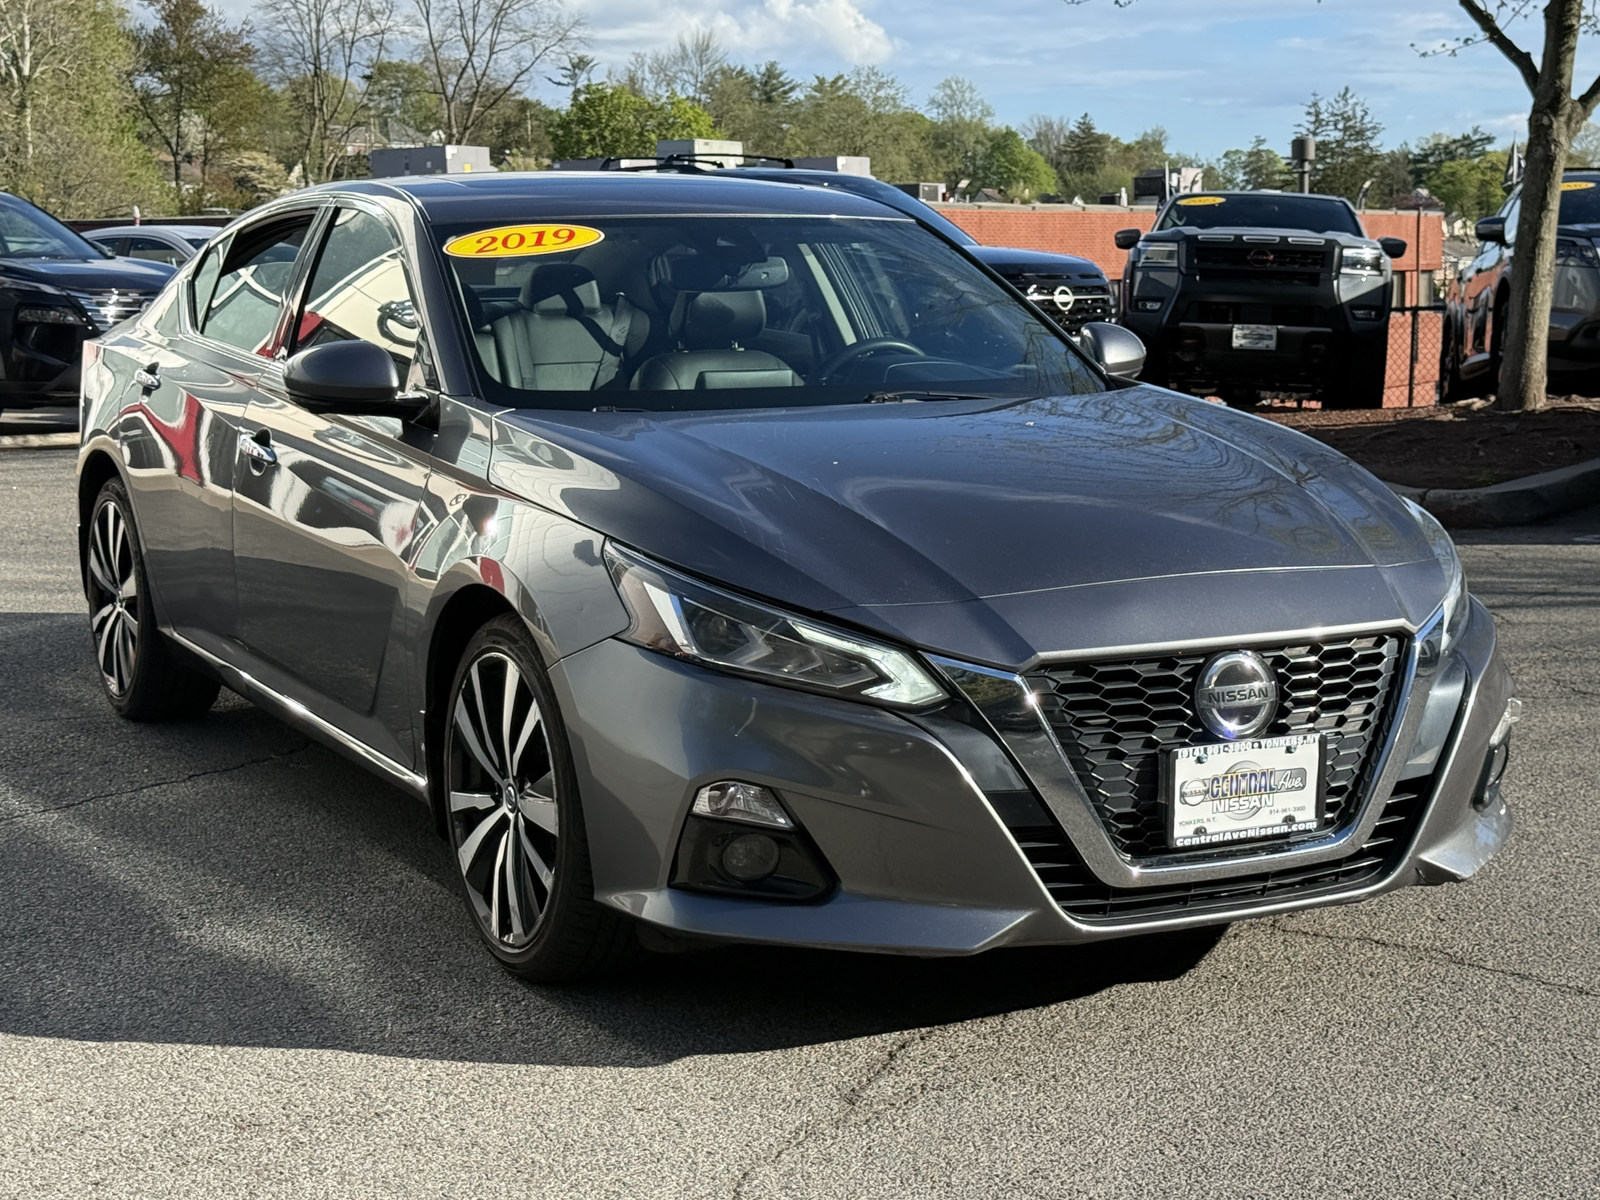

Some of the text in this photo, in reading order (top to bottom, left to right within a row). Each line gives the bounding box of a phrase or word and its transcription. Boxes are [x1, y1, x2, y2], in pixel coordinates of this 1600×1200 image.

[475, 228, 576, 254] 2019
[1208, 687, 1269, 704] NISSAN
[1184, 788, 1206, 796] NISSAN
[1210, 768, 1304, 799] CENTRAL Ave.
[1212, 794, 1274, 814] NISSAN
[1176, 820, 1317, 847] CentralAveNissan.com
